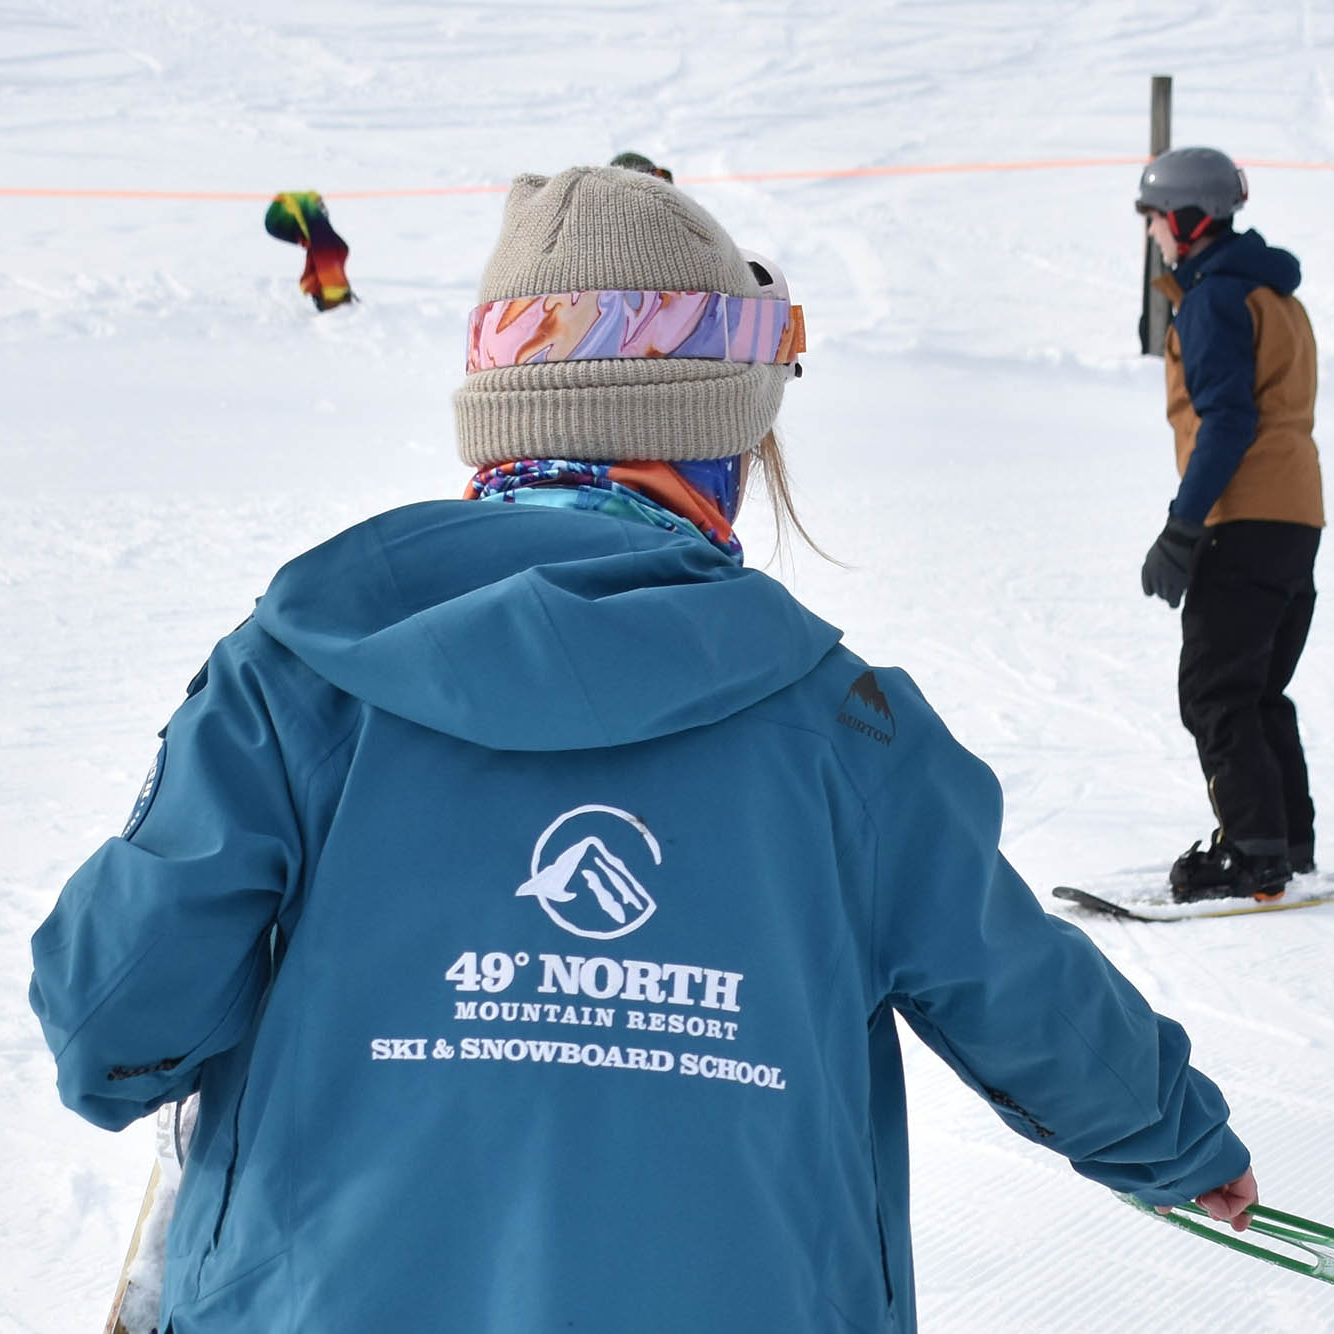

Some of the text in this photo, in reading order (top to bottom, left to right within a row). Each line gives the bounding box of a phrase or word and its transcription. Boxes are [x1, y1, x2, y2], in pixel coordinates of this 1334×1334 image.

[835, 711, 892, 747] BURTON
[445, 951, 744, 1013] 49° NORTH
[453, 1001, 738, 1041] MOUNTAIN RESORT
[370, 1037, 786, 1090] SKI & SNOWBOARD SCHOOL
